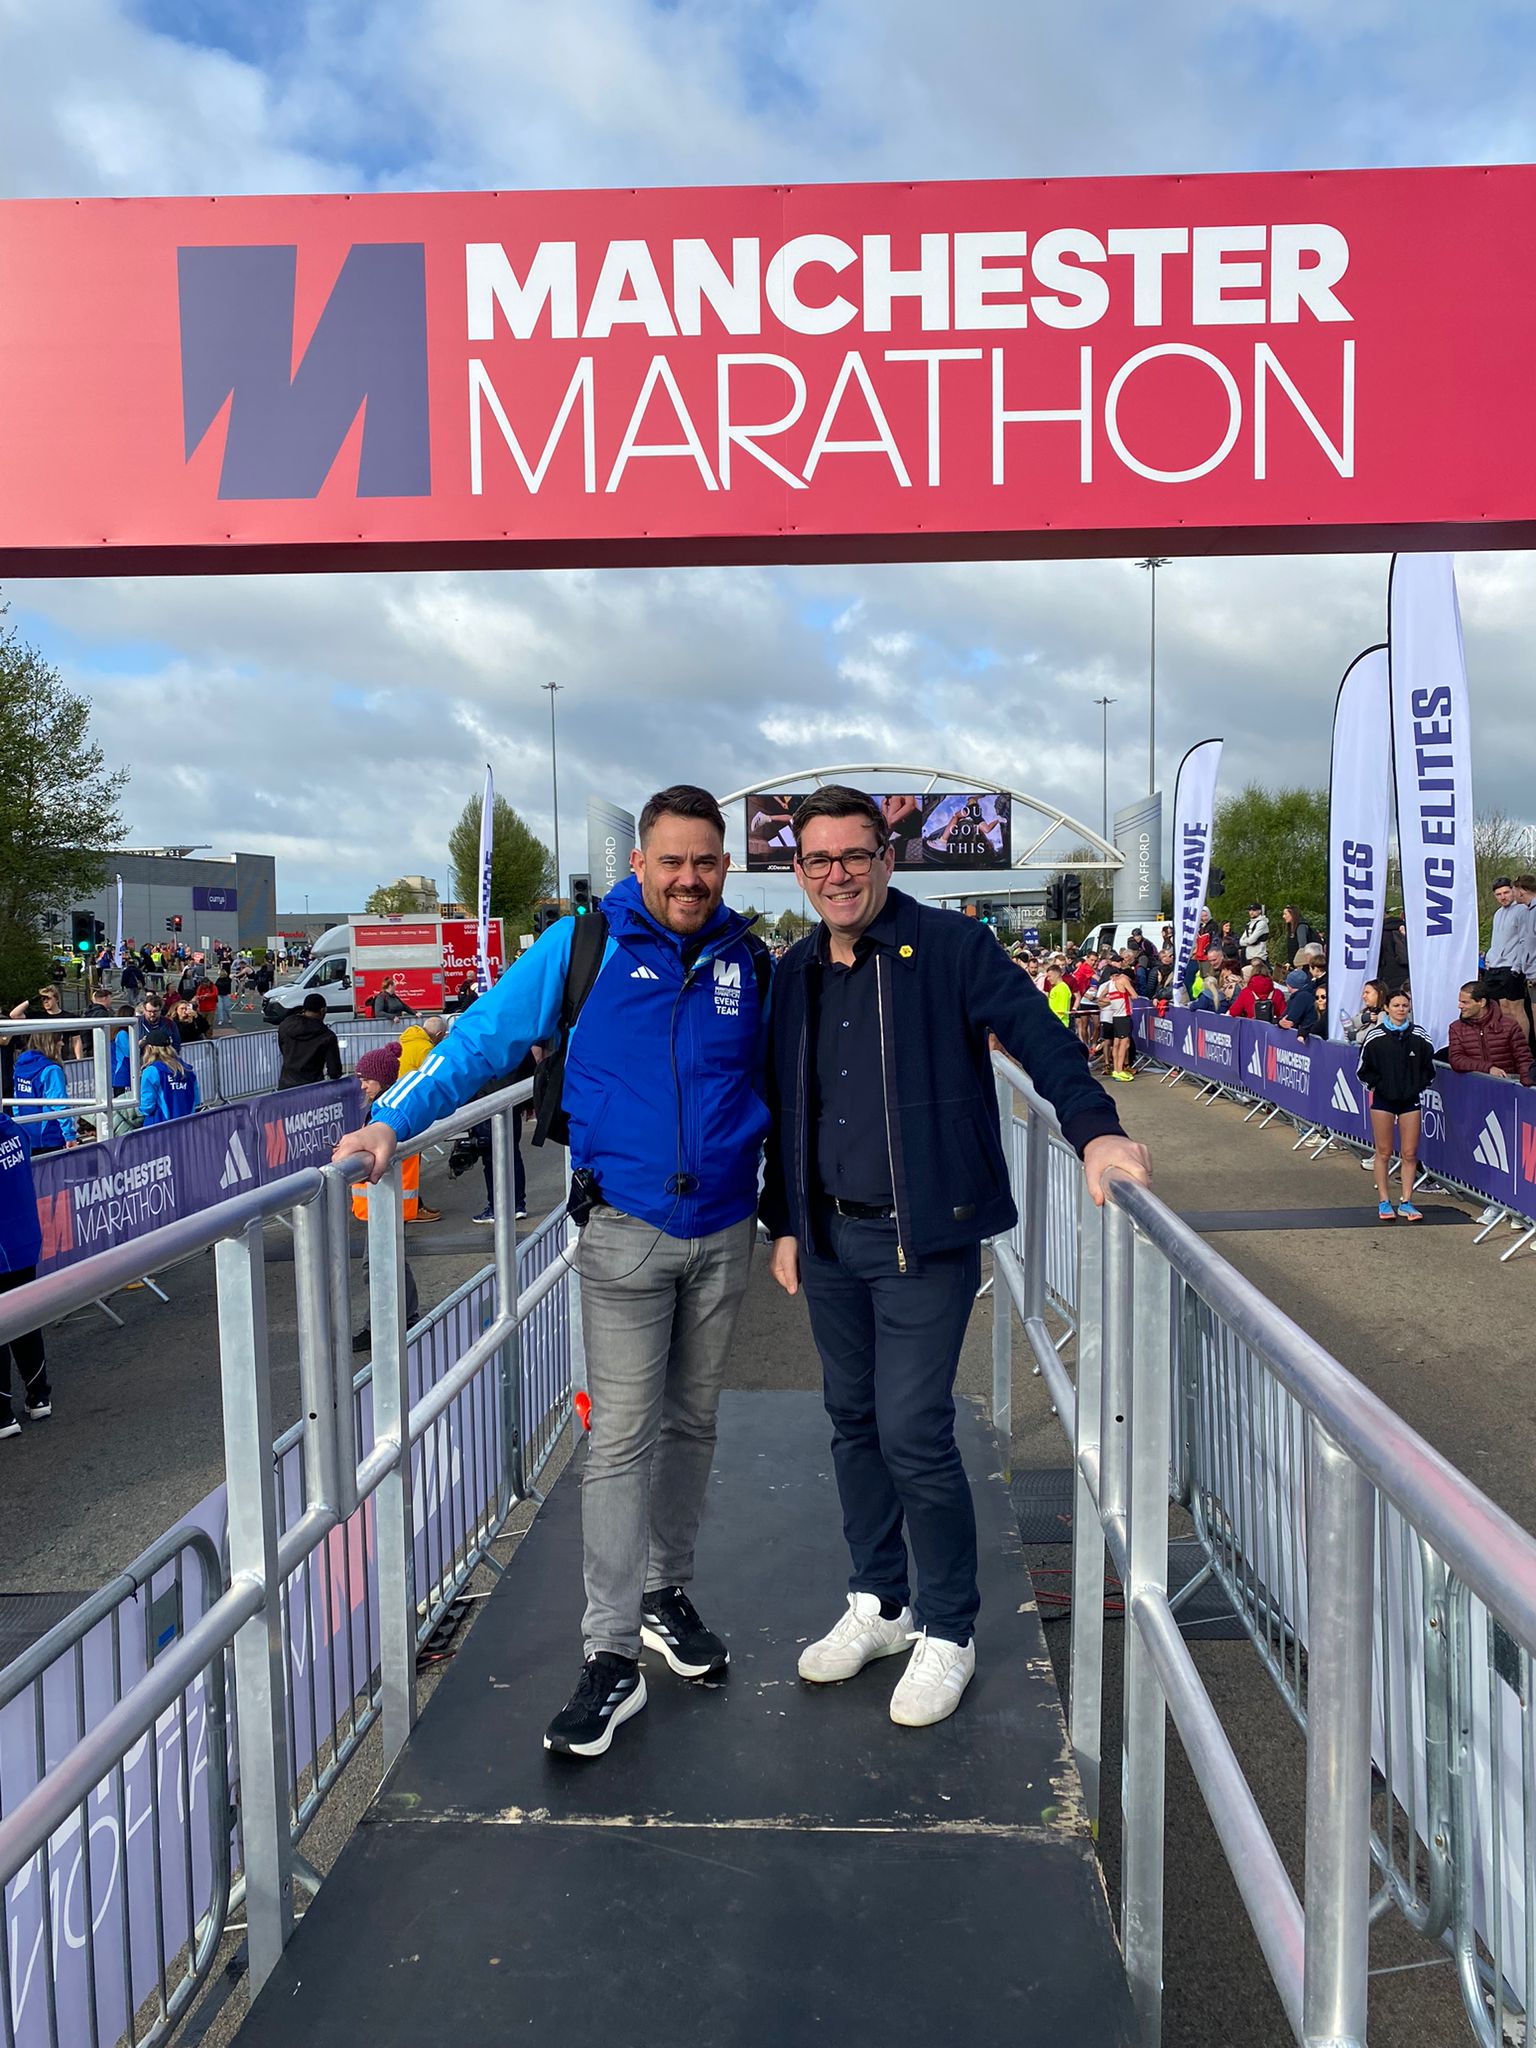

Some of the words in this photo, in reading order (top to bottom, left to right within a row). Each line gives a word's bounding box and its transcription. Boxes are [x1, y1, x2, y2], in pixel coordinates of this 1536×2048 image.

[465, 223, 1354, 341] MANCHESTER
[468, 340, 1355, 495] MARATHON
[1412, 686, 1455, 846] ELITES
[947, 843, 985, 854] THIS
[949, 824, 980, 836] GOT
[605, 836, 616, 895] AFFORD
[1139, 832, 1150, 900] TRAFFORD
[1184, 822, 1209, 901] WAVE
[1342, 839, 1374, 970] ELITES
[1424, 857, 1455, 937] WC
[714, 996, 739, 1007] EVENT
[716, 1005, 739, 1016] TEAM
[1276, 1048, 1311, 1073] MANCHESTER
[1277, 1063, 1311, 1096] MARATHON
[285, 1102, 344, 1134] MANCHESTER
[286, 1120, 345, 1162] MARATHON
[0, 1136, 22, 1156] VENT
[0, 1150, 25, 1171] TEAM
[74, 1155, 173, 1209] MANCHESTER
[76, 1178, 176, 1248] MARATHON
